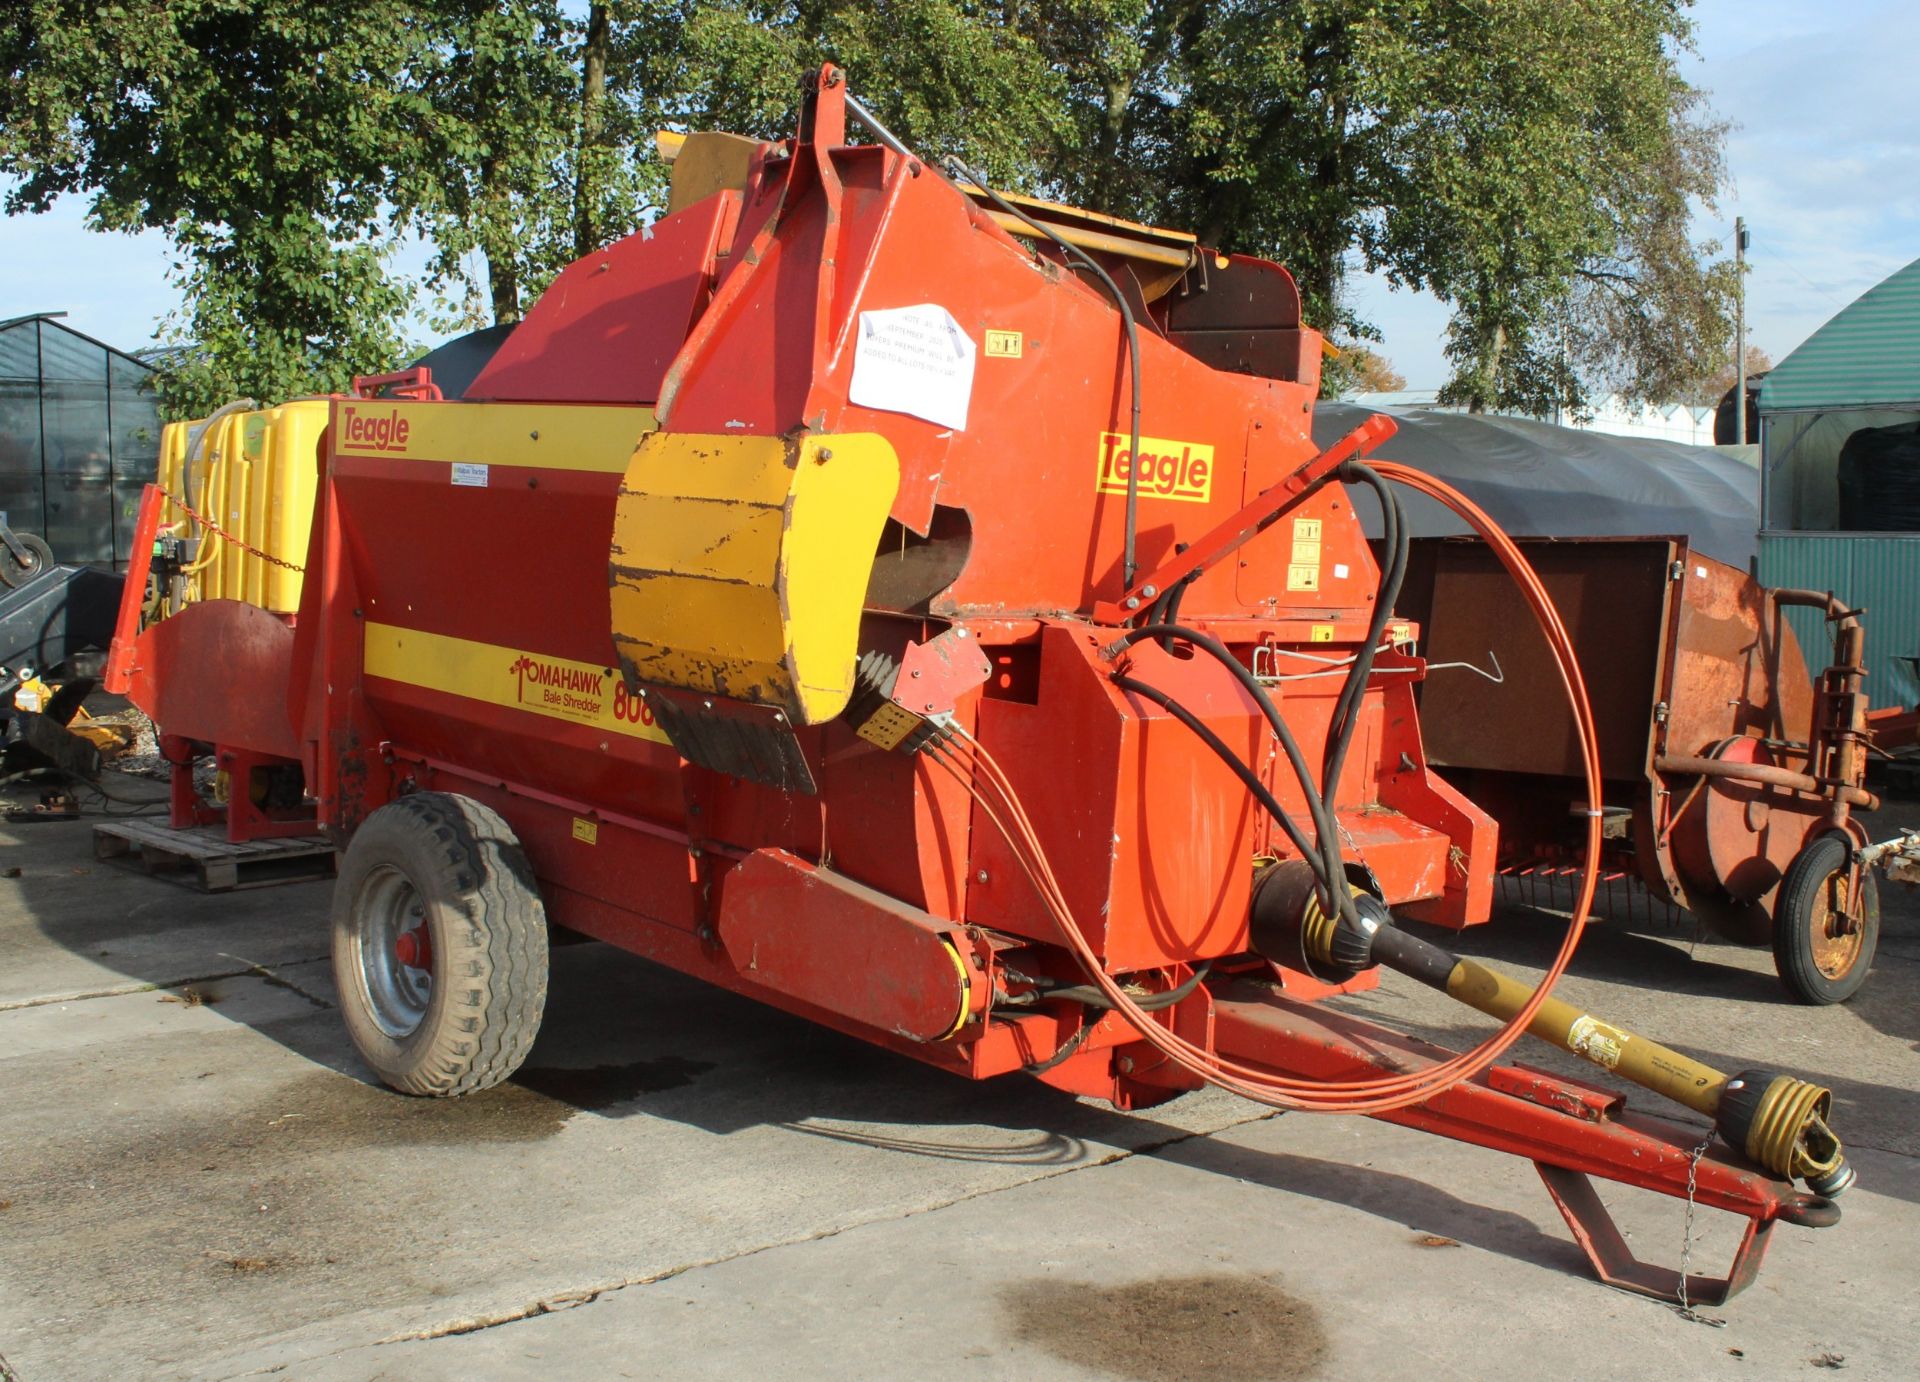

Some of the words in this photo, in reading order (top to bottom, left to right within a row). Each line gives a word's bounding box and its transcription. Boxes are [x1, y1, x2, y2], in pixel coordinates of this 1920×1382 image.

[885, 323, 925, 339] SEPTEMBER
[939, 322, 958, 336] FROM
[863, 347, 887, 360] ADDED
[909, 359, 925, 371] LOTS
[894, 340, 925, 355] PREMIUM
[928, 350, 943, 361] WILL
[344, 407, 410, 451] Teagle
[1103, 434, 1209, 495] Teagle
[509, 655, 603, 703] TOMAHAWK
[544, 689, 561, 704] Bale
[562, 693, 602, 713] Shredder
